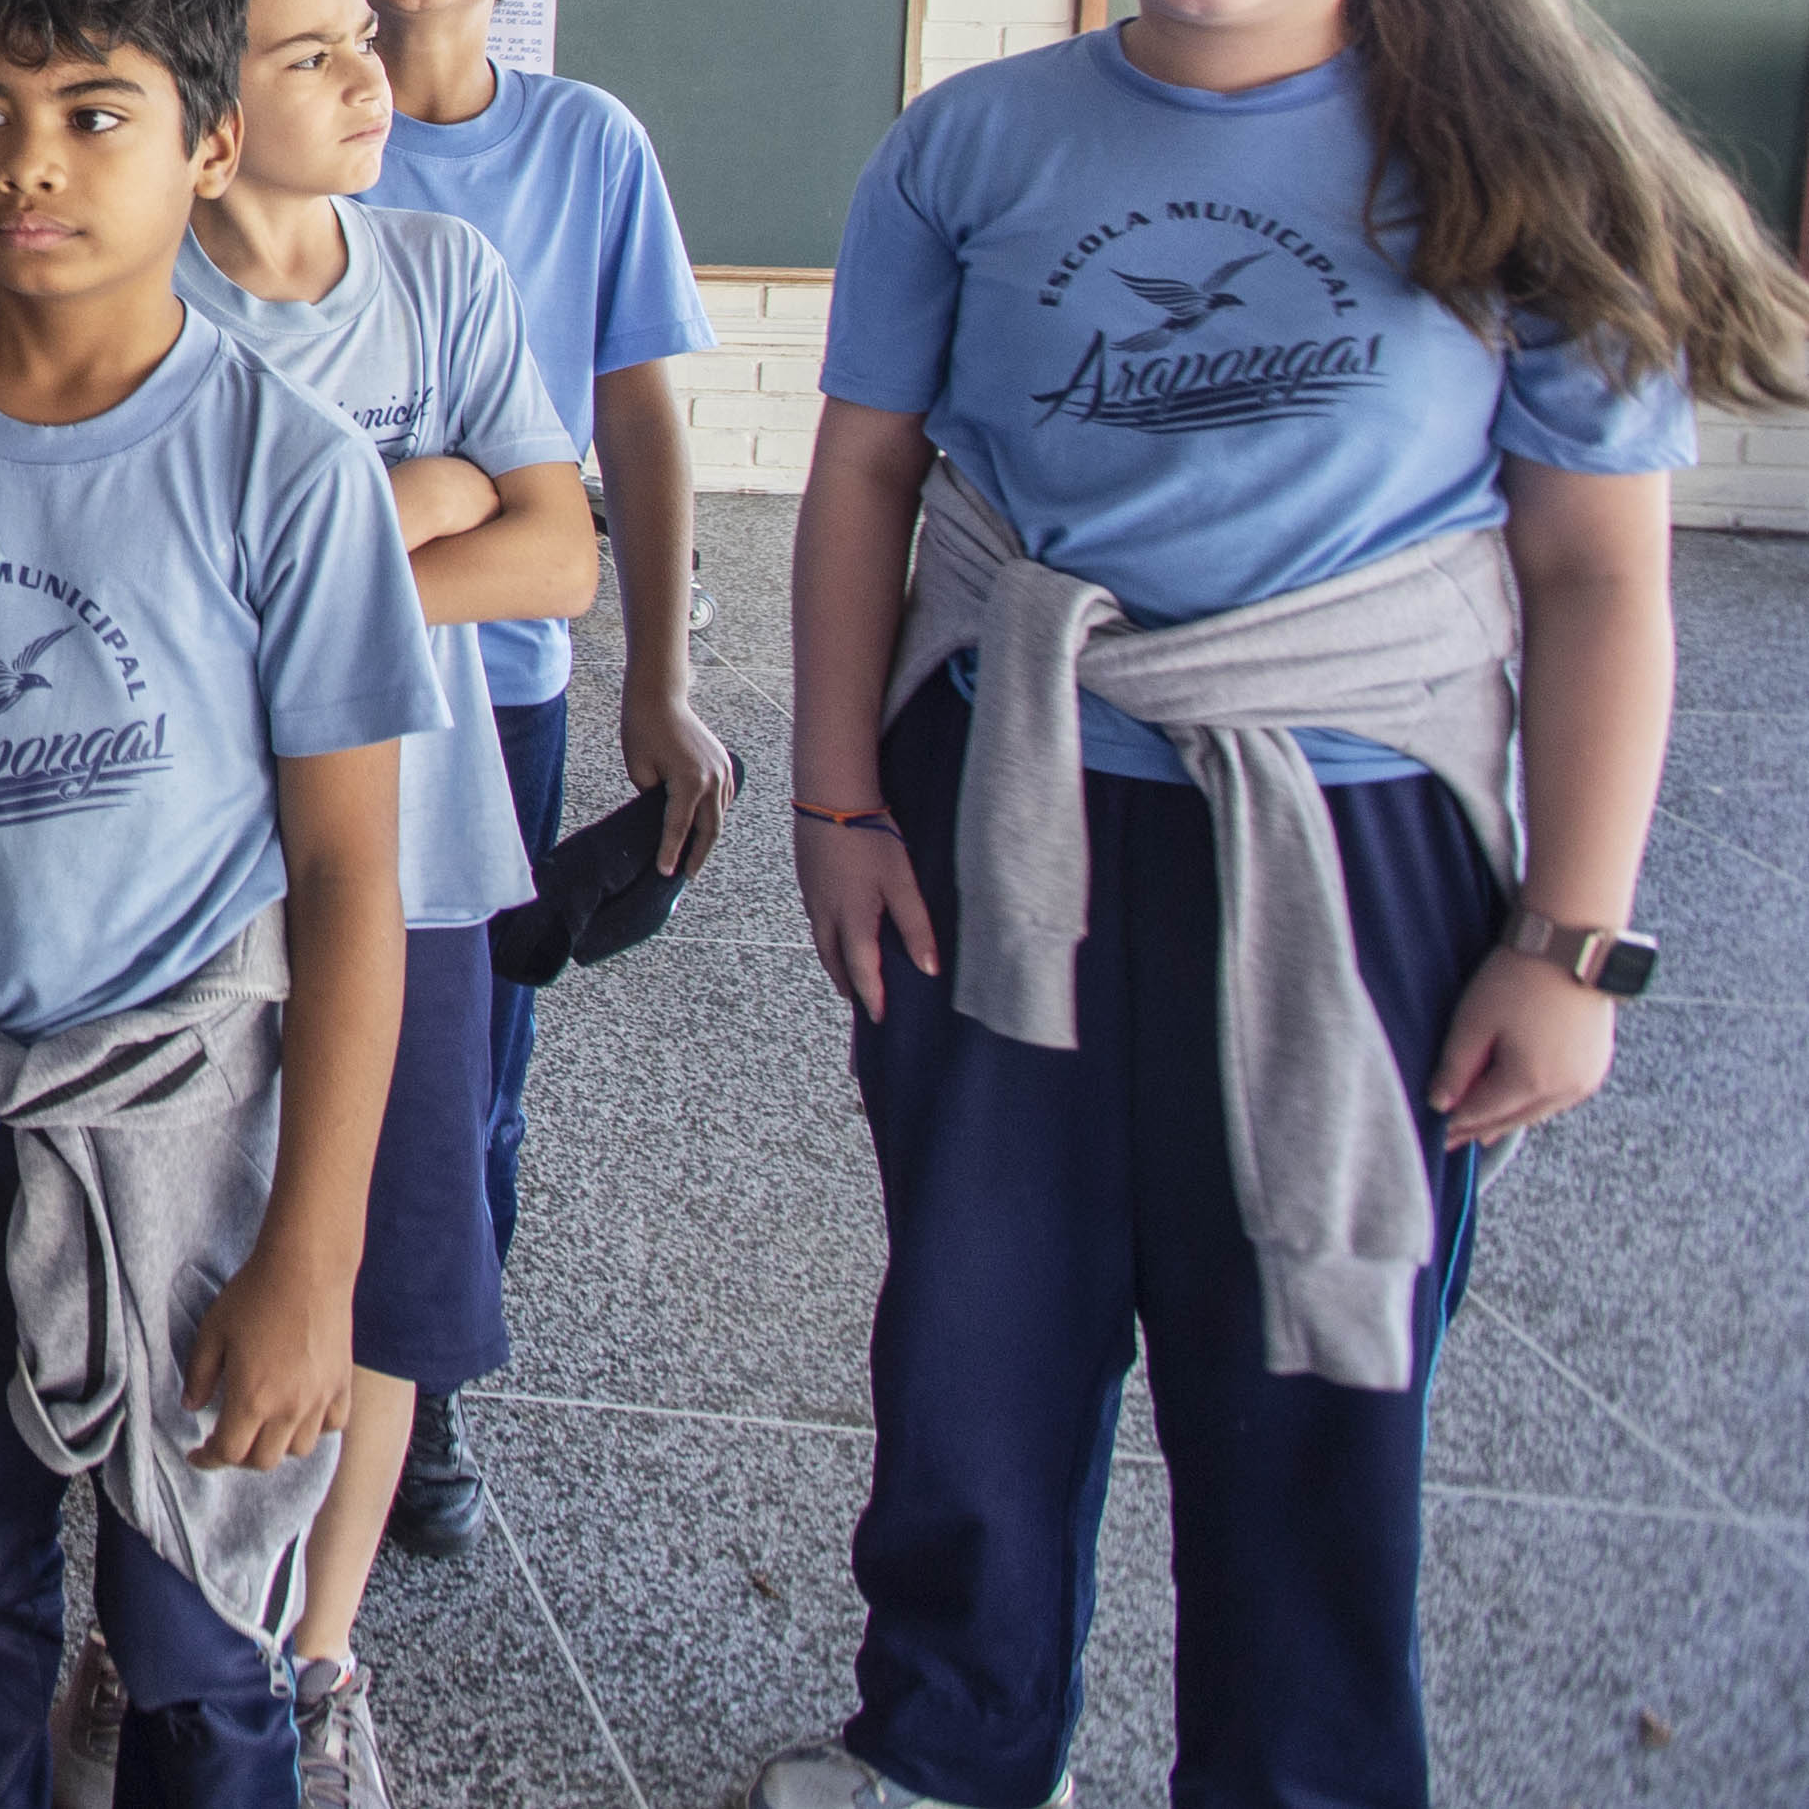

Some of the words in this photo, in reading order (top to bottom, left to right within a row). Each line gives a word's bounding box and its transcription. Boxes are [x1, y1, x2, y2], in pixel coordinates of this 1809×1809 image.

[1038, 210, 1152, 309] ESCOLA
[1165, 201, 1360, 318] MUNICIPAL
[1030, 329, 1388, 429] Arapongas
